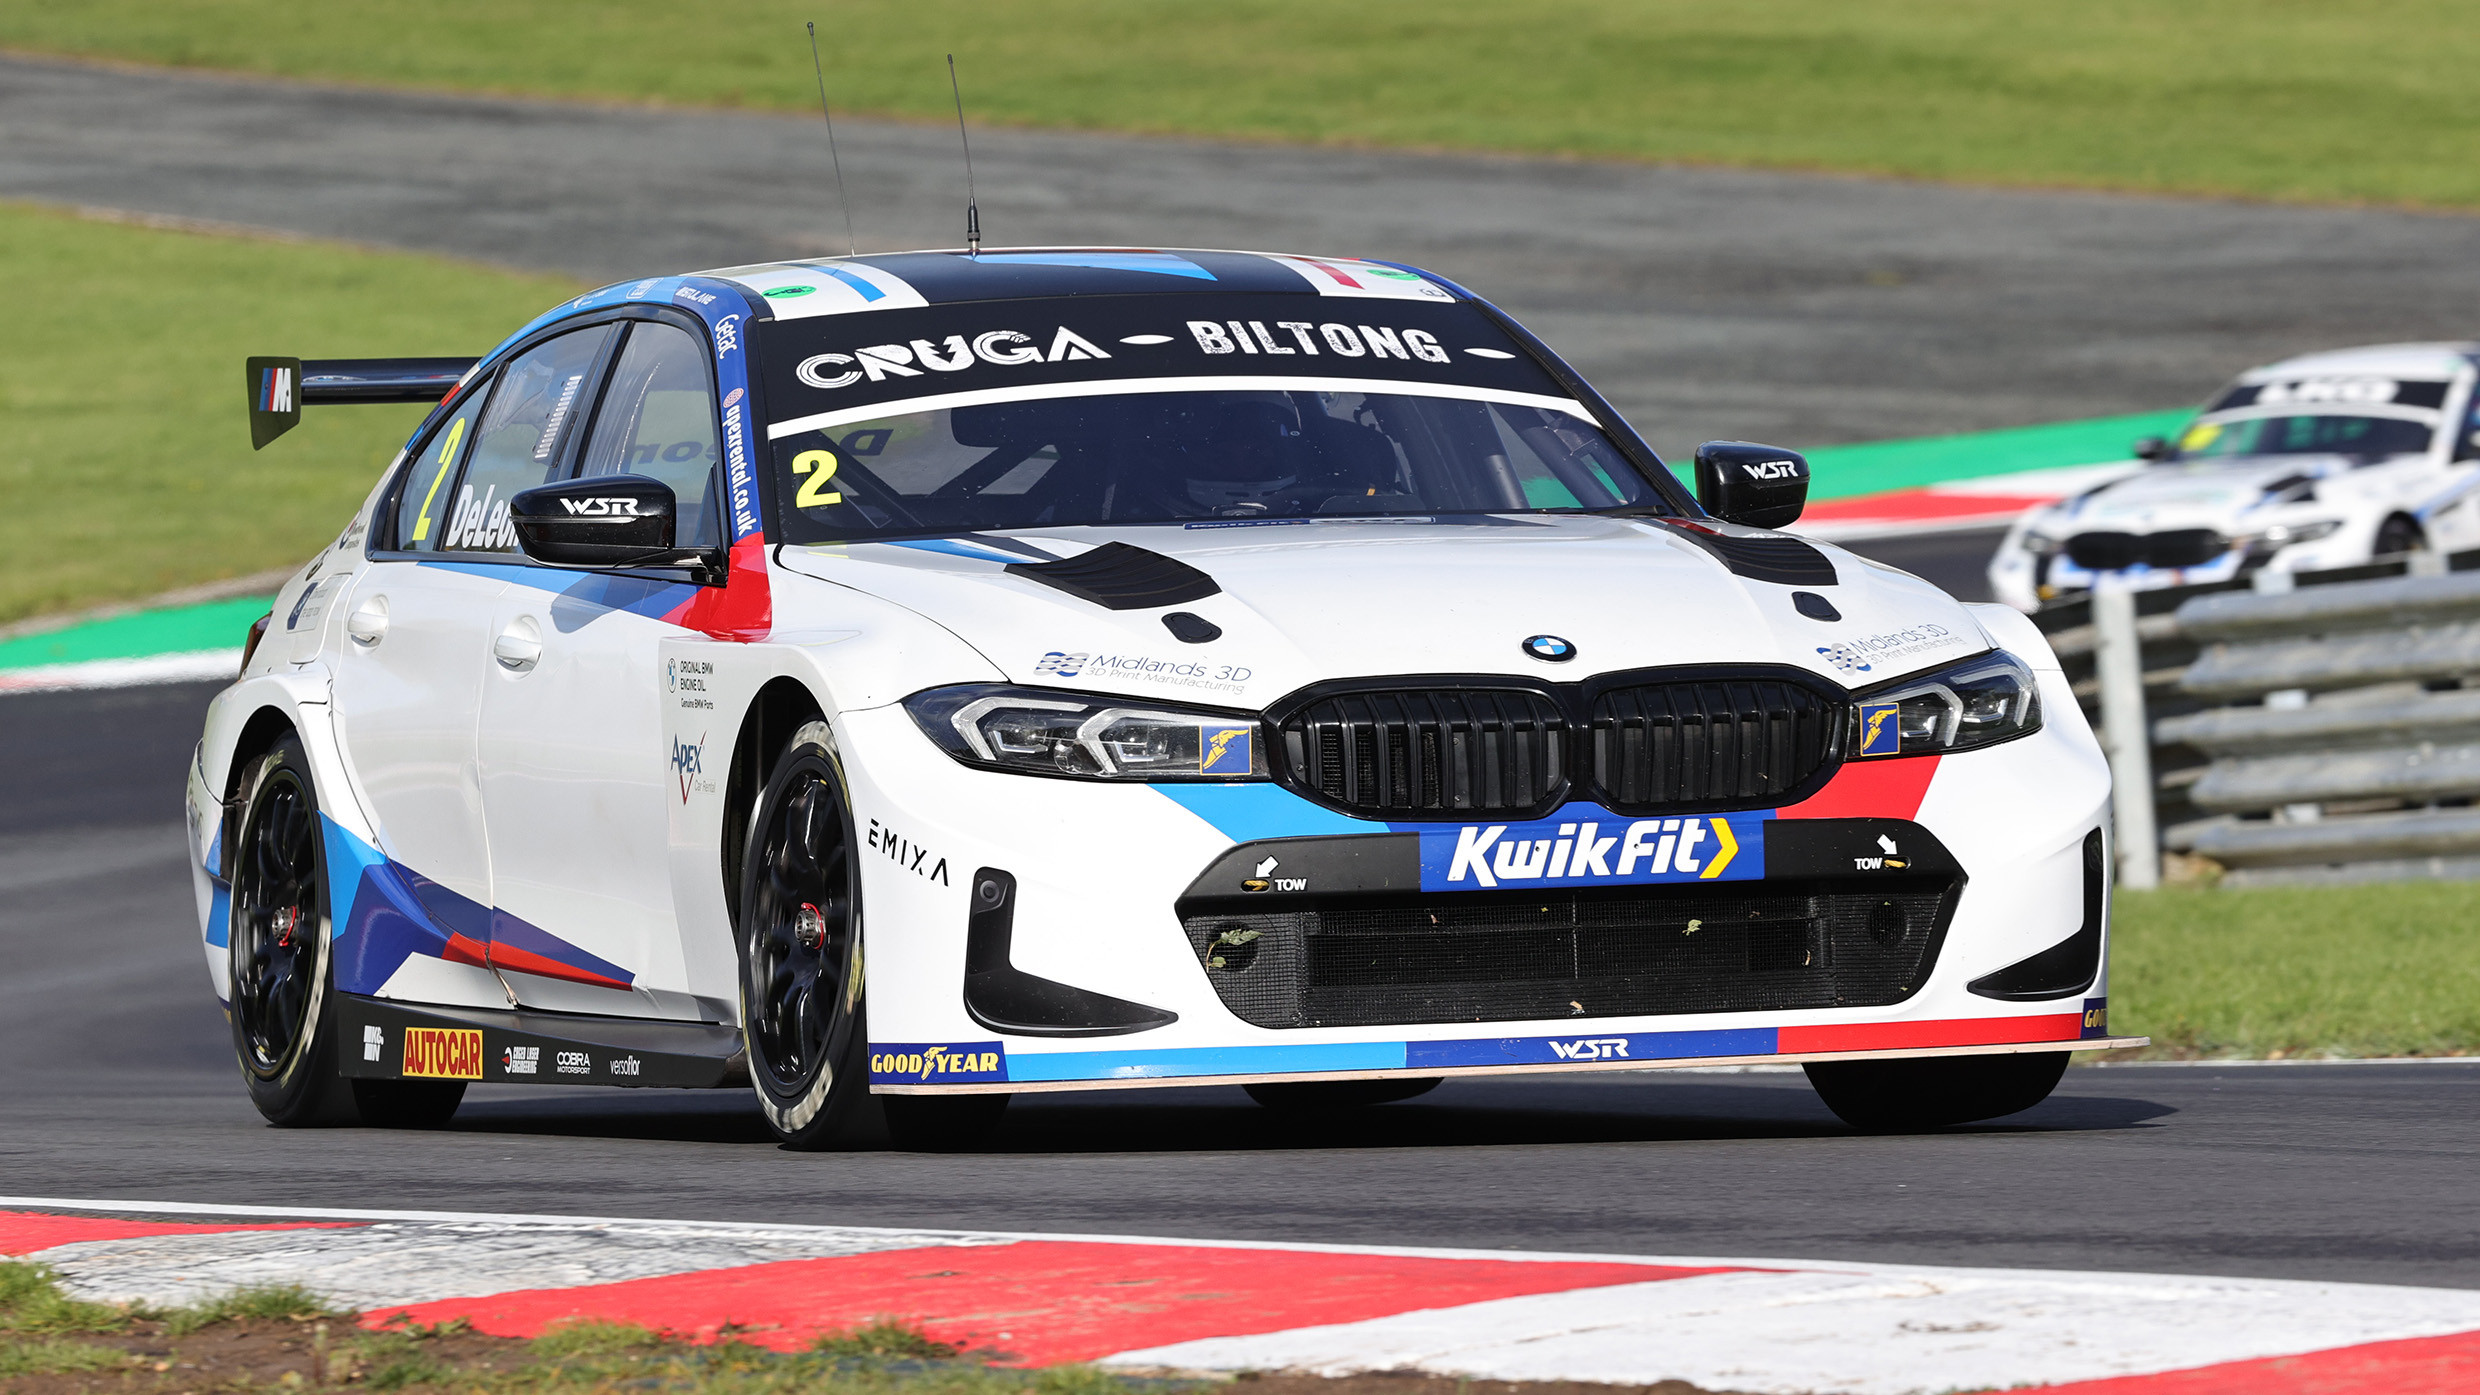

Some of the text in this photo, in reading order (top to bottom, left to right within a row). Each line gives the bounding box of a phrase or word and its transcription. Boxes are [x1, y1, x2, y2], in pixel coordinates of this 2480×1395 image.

[715, 314, 740, 359] Getac
[796, 320, 1451, 389] CRUGA BILTONG
[412, 417, 466, 541] 2
[722, 404, 757, 537] apexrental.co.uk
[792, 449, 842, 508] 2
[1742, 460, 1798, 480] WSR
[559, 497, 639, 515] WSR
[1848, 623, 1949, 655] Midlands 3D
[1085, 666, 1245, 696] 3D Print Manufacturing
[1090, 654, 1252, 683] Midlands 3D
[868, 818, 949, 887] EMIXA
[1854, 856, 1883, 871] TOW
[1274, 878, 1307, 892] TOW
[404, 1030, 481, 1076] AUTOCAR
[556, 1051, 591, 1067] COBRA
[1548, 1038, 1630, 1060] WSR
[556, 1066, 591, 1075] MOTORSPORT
